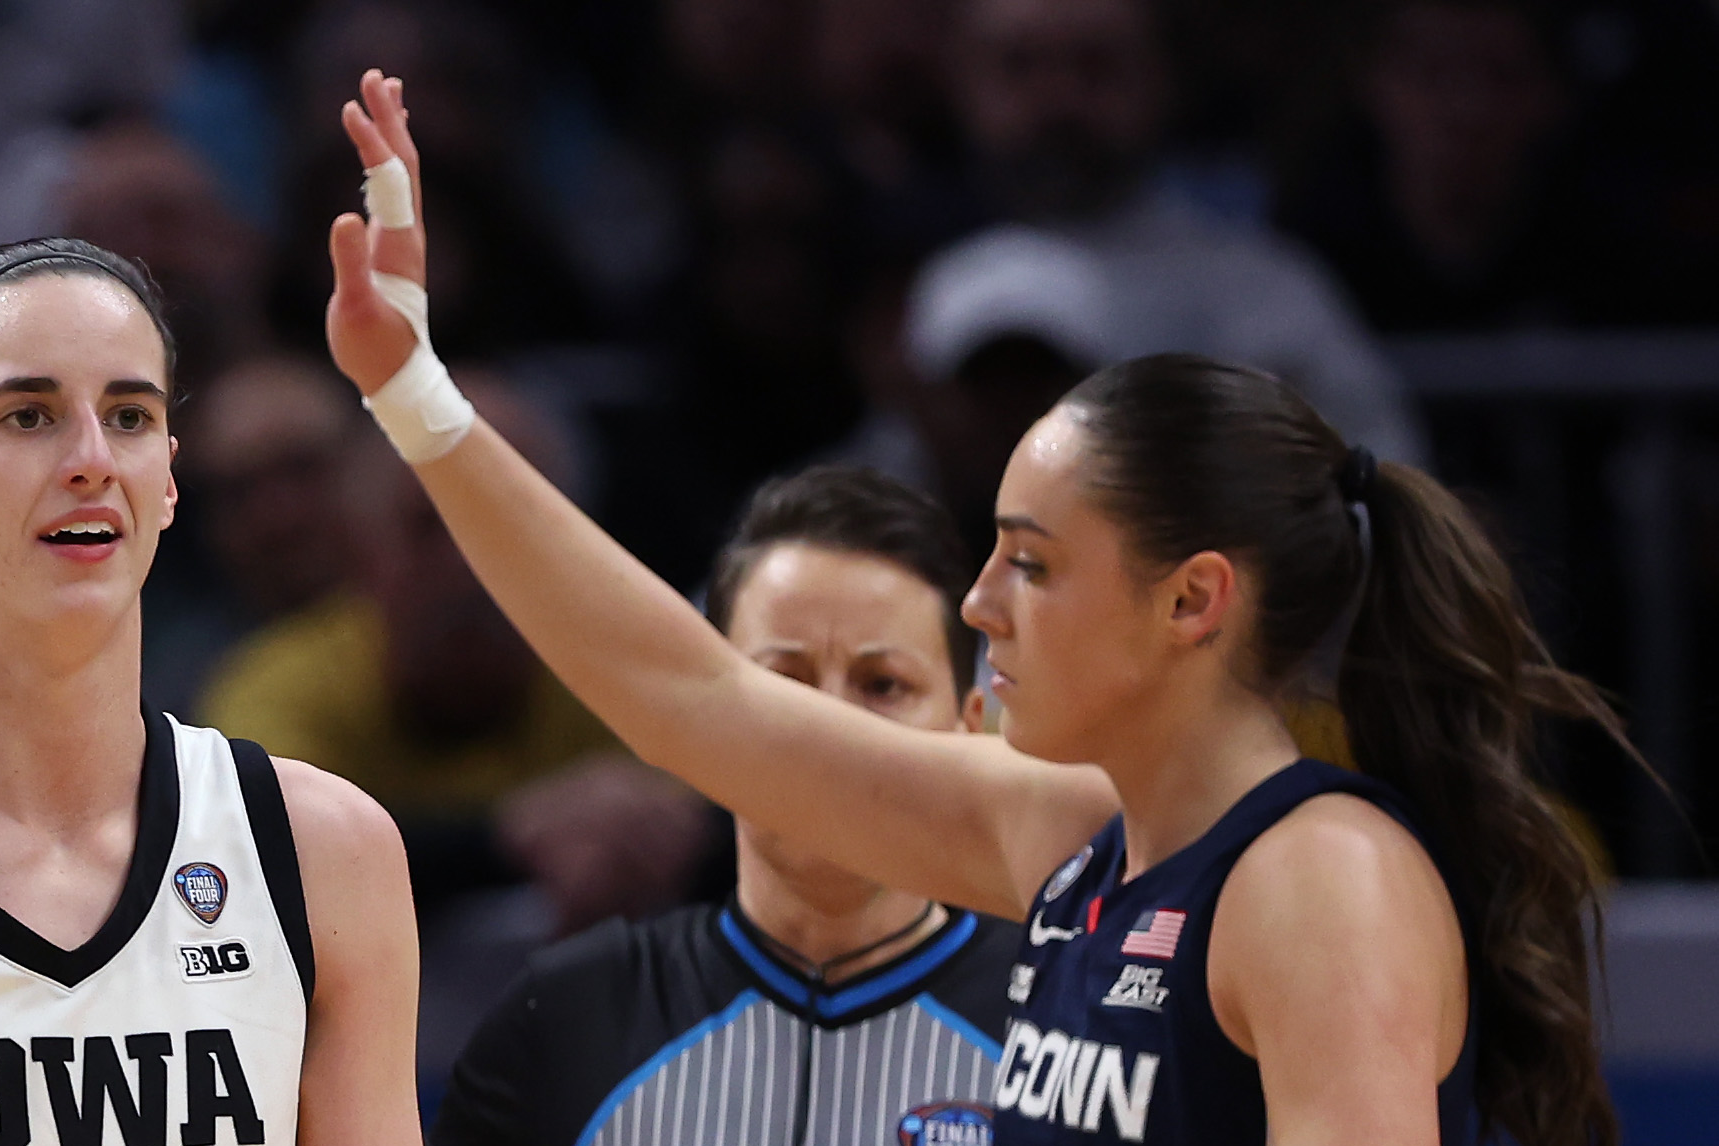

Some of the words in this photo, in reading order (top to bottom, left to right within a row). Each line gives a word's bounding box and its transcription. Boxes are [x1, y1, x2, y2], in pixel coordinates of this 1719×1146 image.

[186, 875, 217, 889] FINAL
[189, 888, 220, 903] FOUR
[992, 1018, 1161, 1143] CONN
